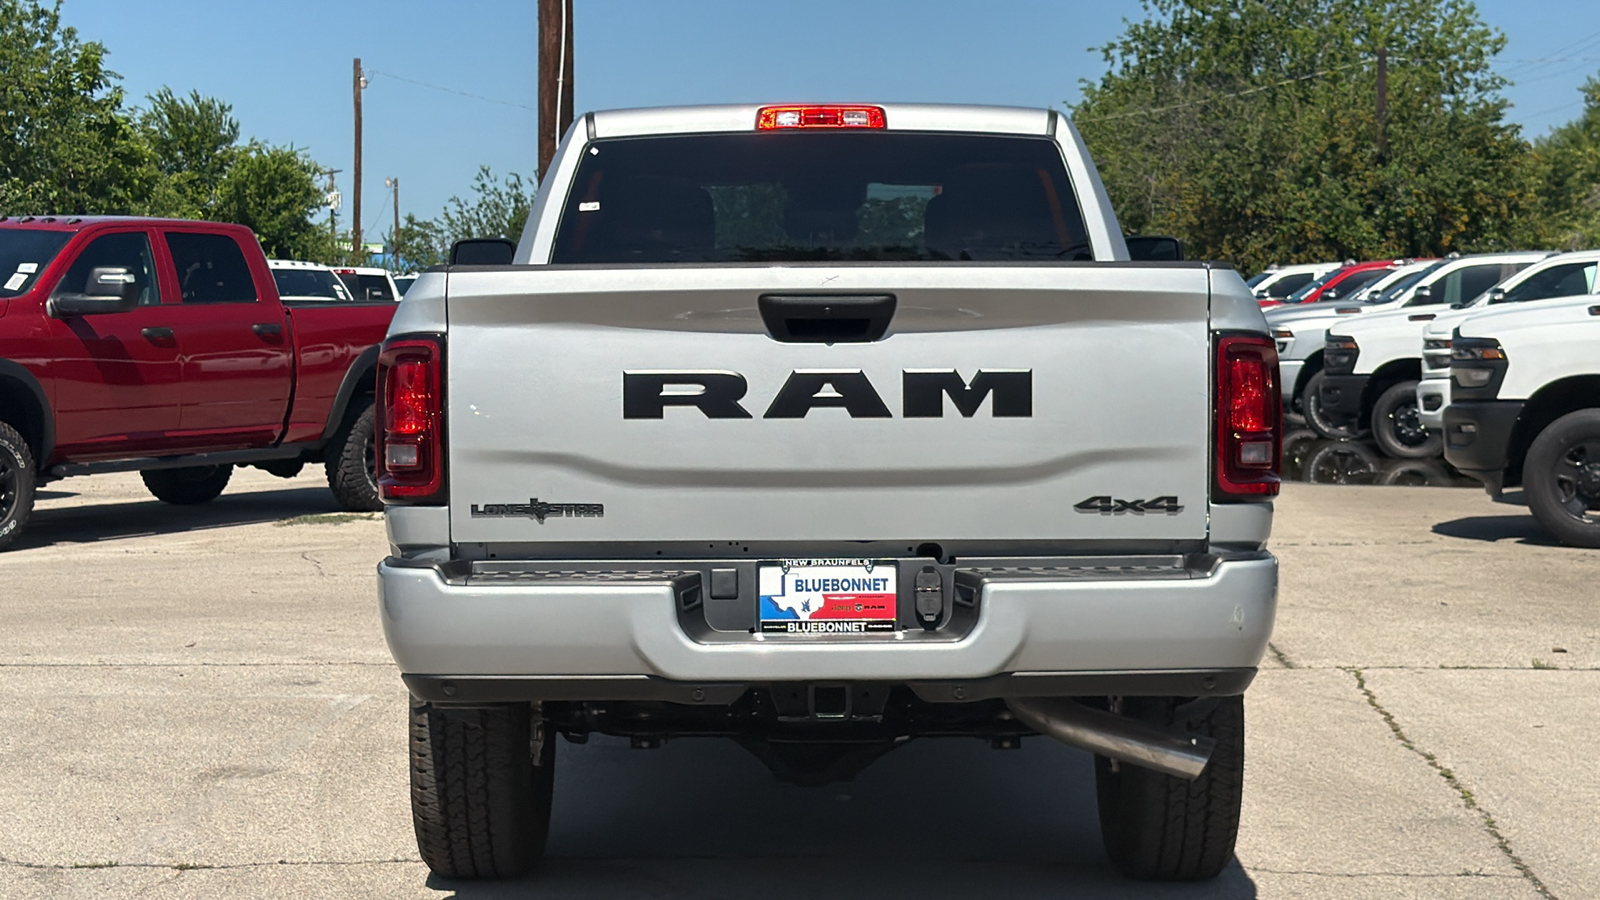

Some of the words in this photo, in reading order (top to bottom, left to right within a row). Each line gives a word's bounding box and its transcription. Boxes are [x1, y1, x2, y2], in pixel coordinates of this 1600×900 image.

[623, 368, 1033, 419] RAM
[471, 503, 531, 518] LONE
[549, 503, 604, 518] STAR
[785, 558, 809, 566] NEW
[811, 558, 870, 566] BRAUNFELS
[795, 578, 888, 592] BLUEBONNET
[787, 622, 867, 633] BLUEBONNET
